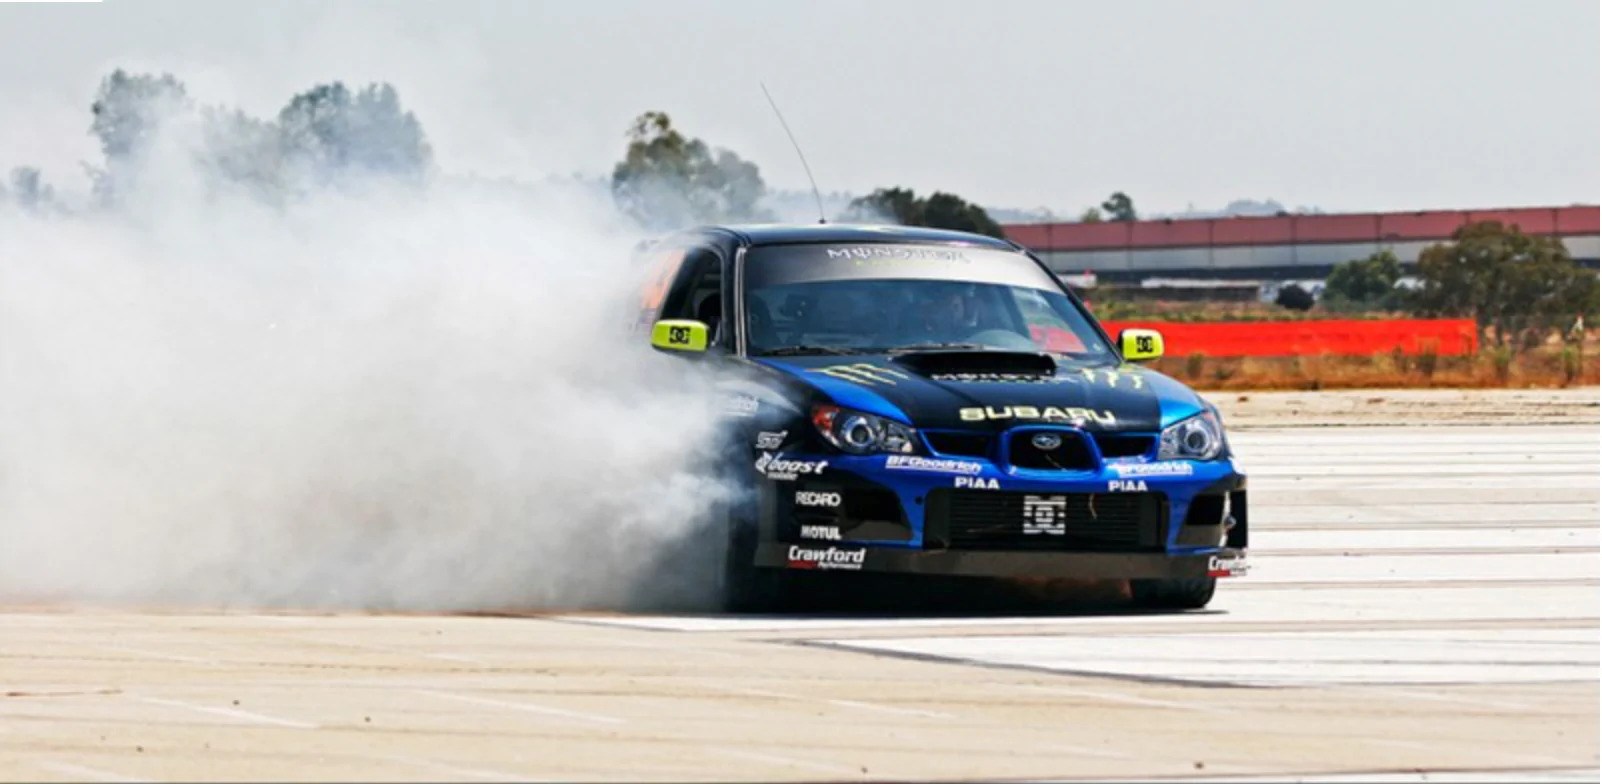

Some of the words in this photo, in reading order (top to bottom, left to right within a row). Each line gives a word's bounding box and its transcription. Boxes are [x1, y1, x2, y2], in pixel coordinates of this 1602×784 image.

[959, 405, 1116, 424] SUBARU
[955, 475, 1000, 490] PIAA
[1108, 479, 1148, 492] PIAA
[795, 491, 842, 507] RECARO
[801, 525, 842, 540] MOTUL
[788, 545, 866, 563] Crawford
